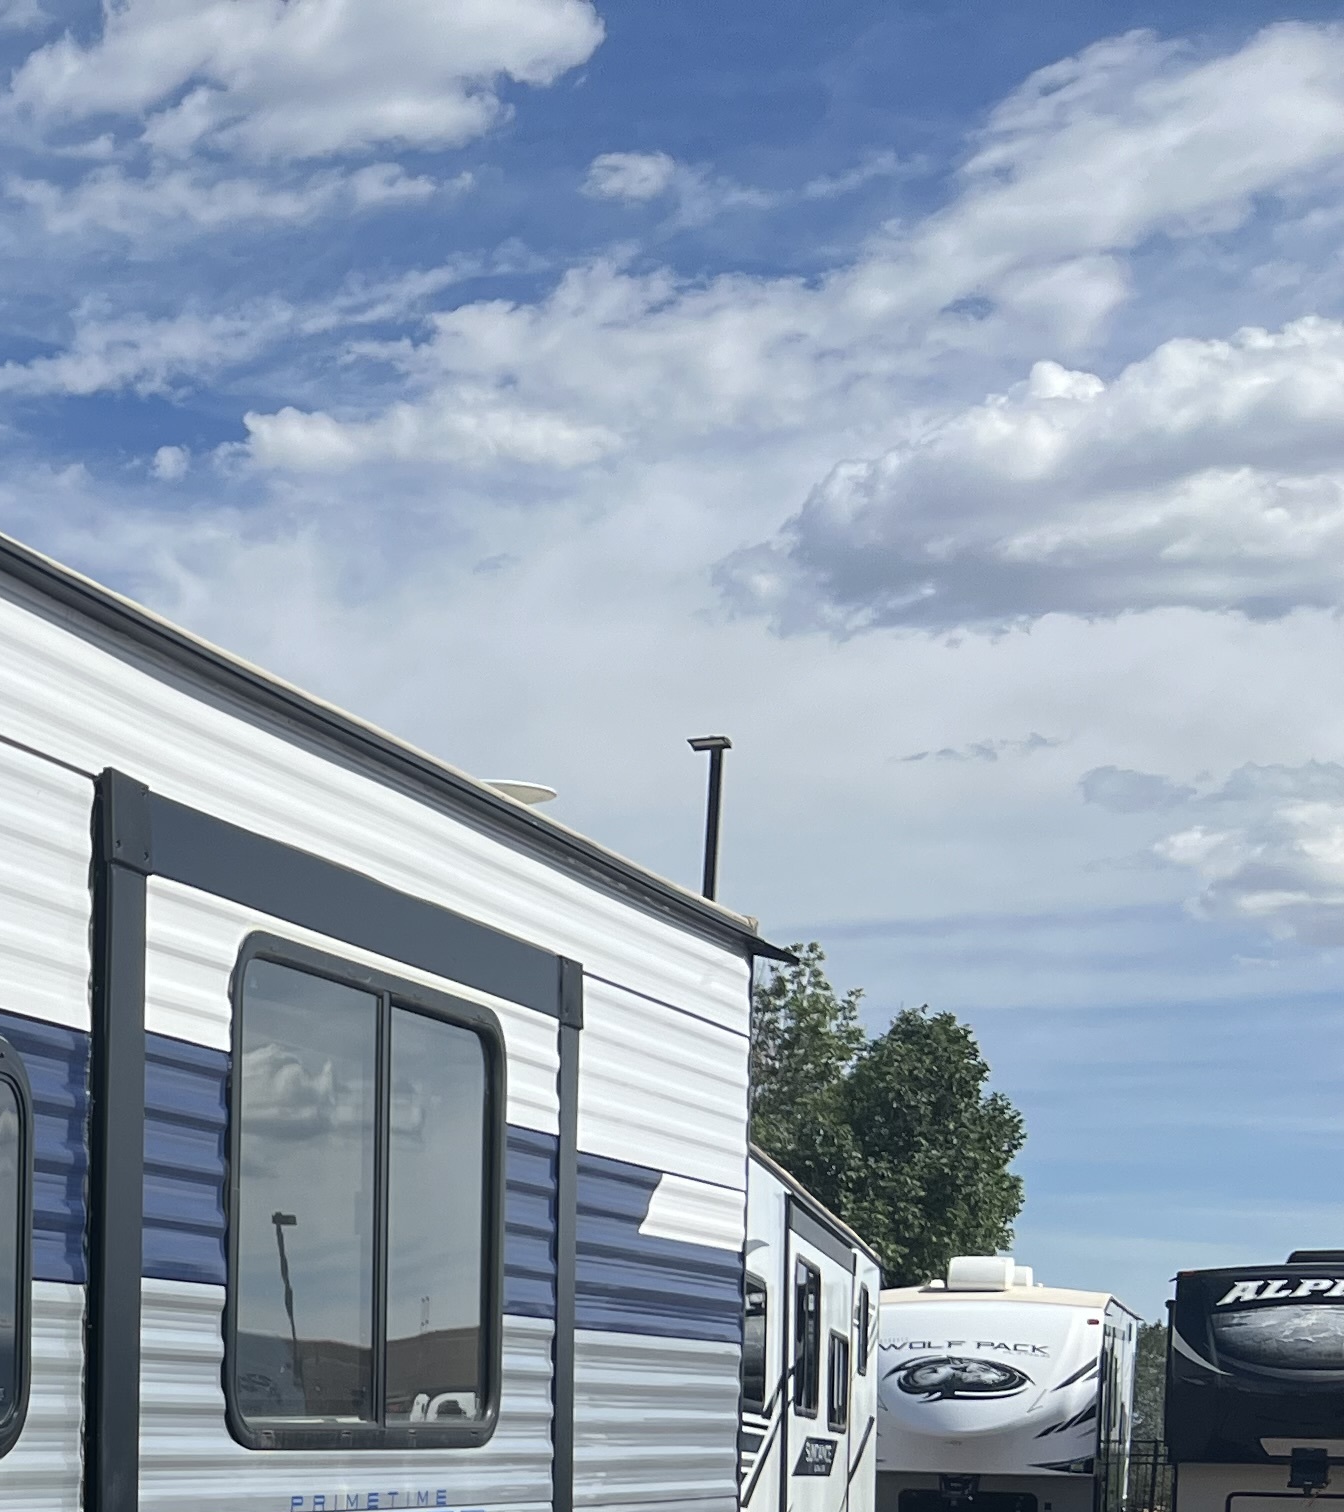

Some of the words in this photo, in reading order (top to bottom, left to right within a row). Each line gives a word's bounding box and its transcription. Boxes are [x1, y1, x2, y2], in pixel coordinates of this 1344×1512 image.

[878, 1340, 966, 1352] WOLF
[976, 1340, 1050, 1355] PACK
[290, 1489, 447, 1512] PRIMETIME
